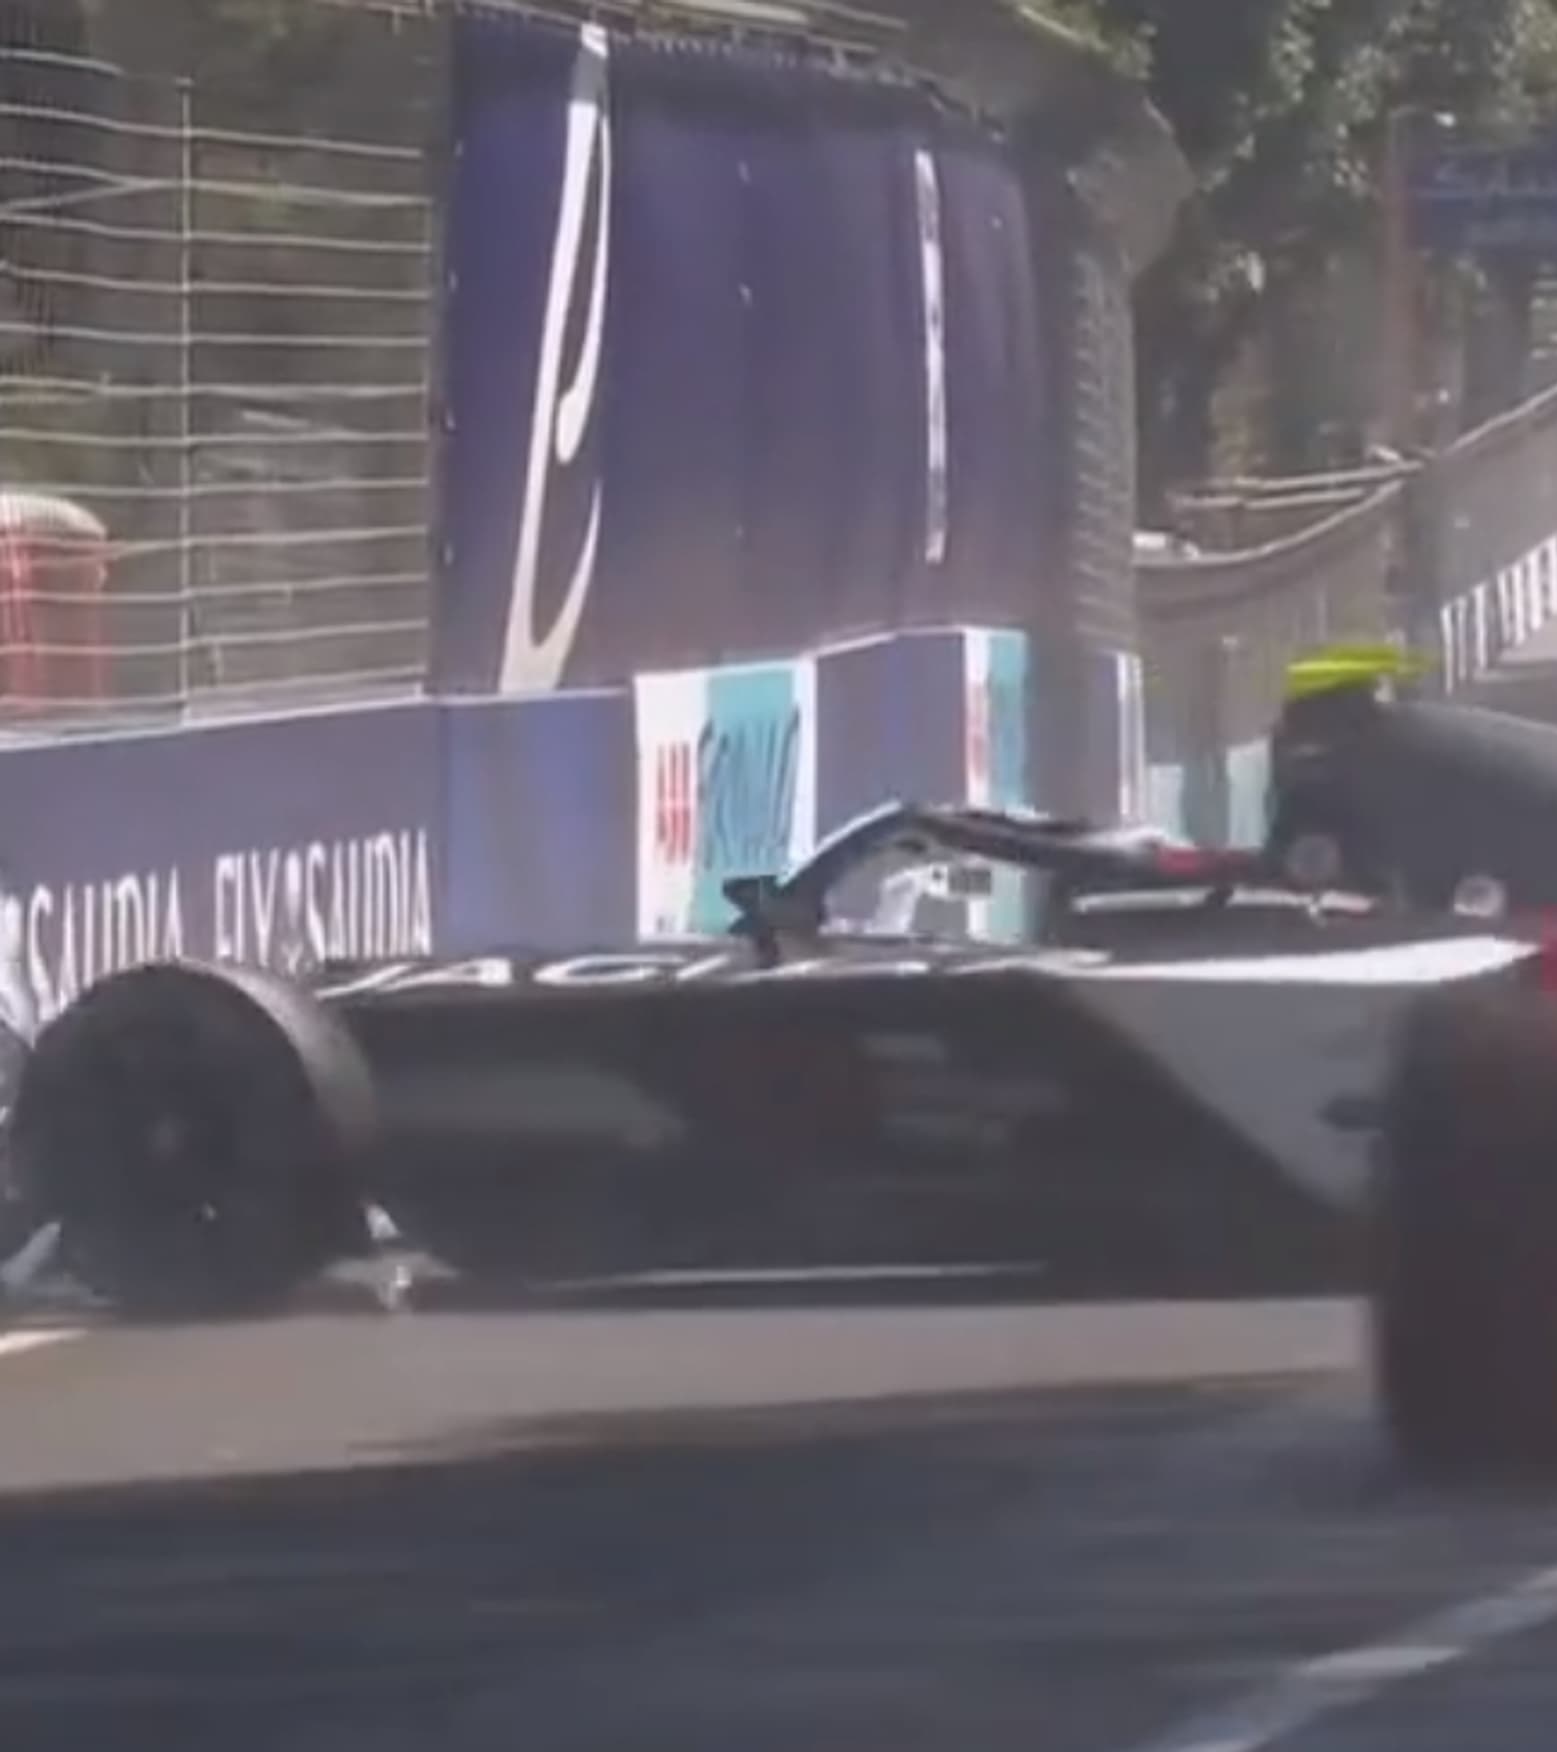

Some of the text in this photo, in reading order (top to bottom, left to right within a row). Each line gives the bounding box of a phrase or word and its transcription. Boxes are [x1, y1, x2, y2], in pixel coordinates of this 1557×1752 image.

[27, 864, 183, 1022] SAUDIA
[214, 826, 432, 967] FLY SAUDIA
